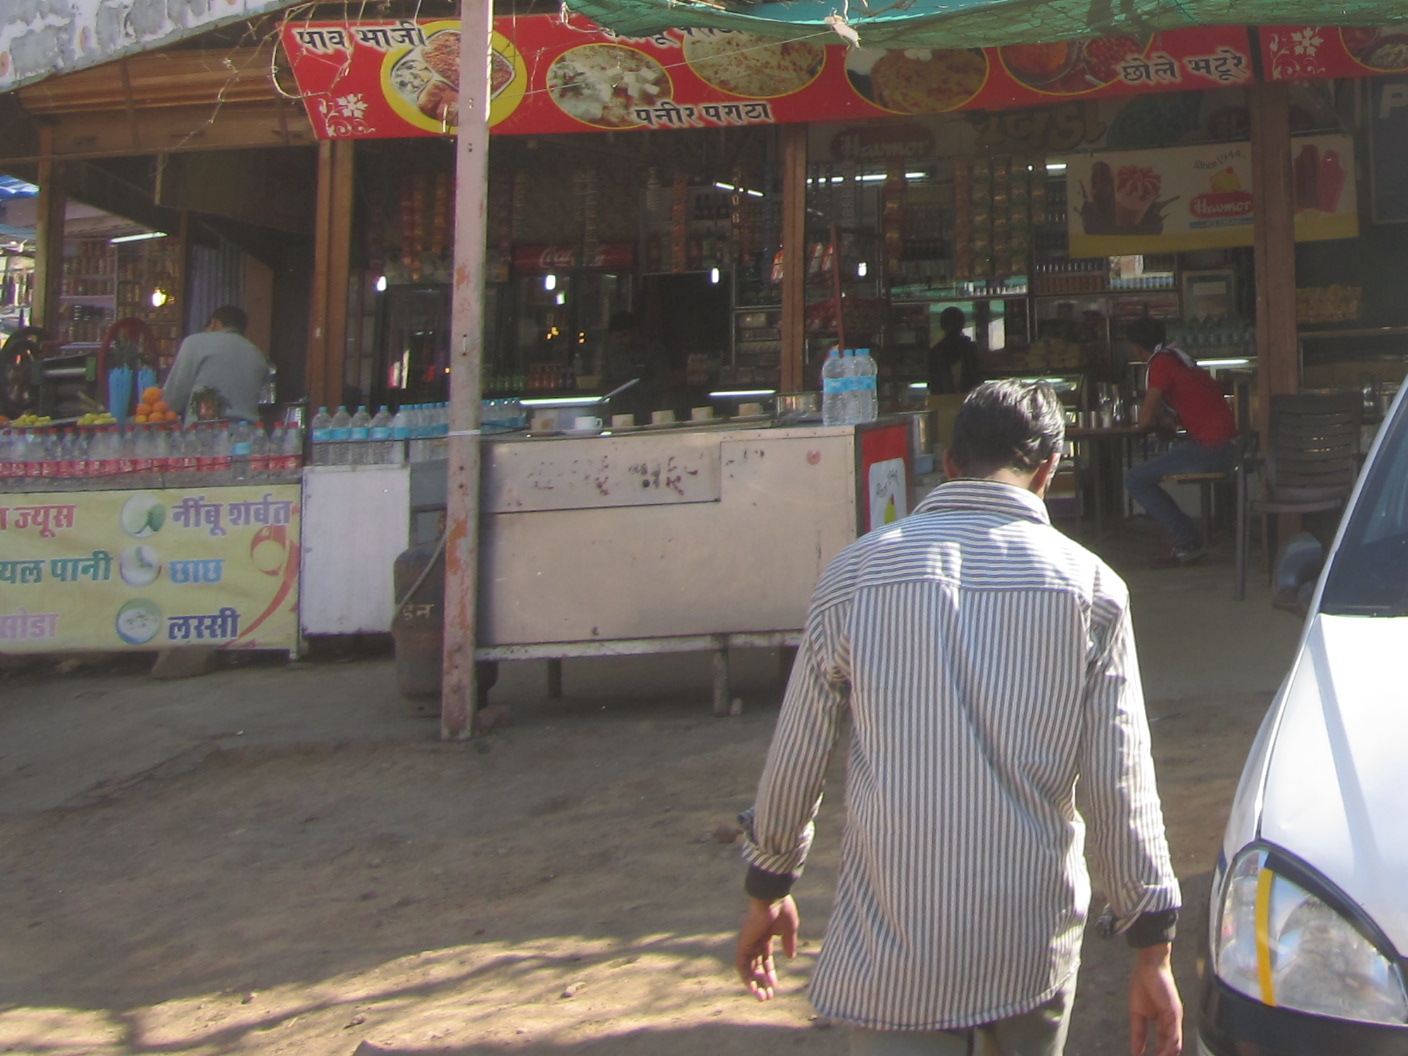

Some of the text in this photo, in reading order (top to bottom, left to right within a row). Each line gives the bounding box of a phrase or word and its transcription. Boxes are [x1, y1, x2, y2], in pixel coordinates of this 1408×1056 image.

[296, 20, 428, 50] पाव भाजी
[1121, 49, 1249, 82] छोले भटूरे
[634, 101, 774, 128] पनीर पराठा
[1193, 198, 1252, 215] Havmor
[14, 504, 76, 538] ज्यूस
[229, 494, 294, 526] शर्बत
[51, 550, 114, 582] पानी
[169, 559, 226, 584] छाछ
[168, 607, 241, 640] लस्सी
